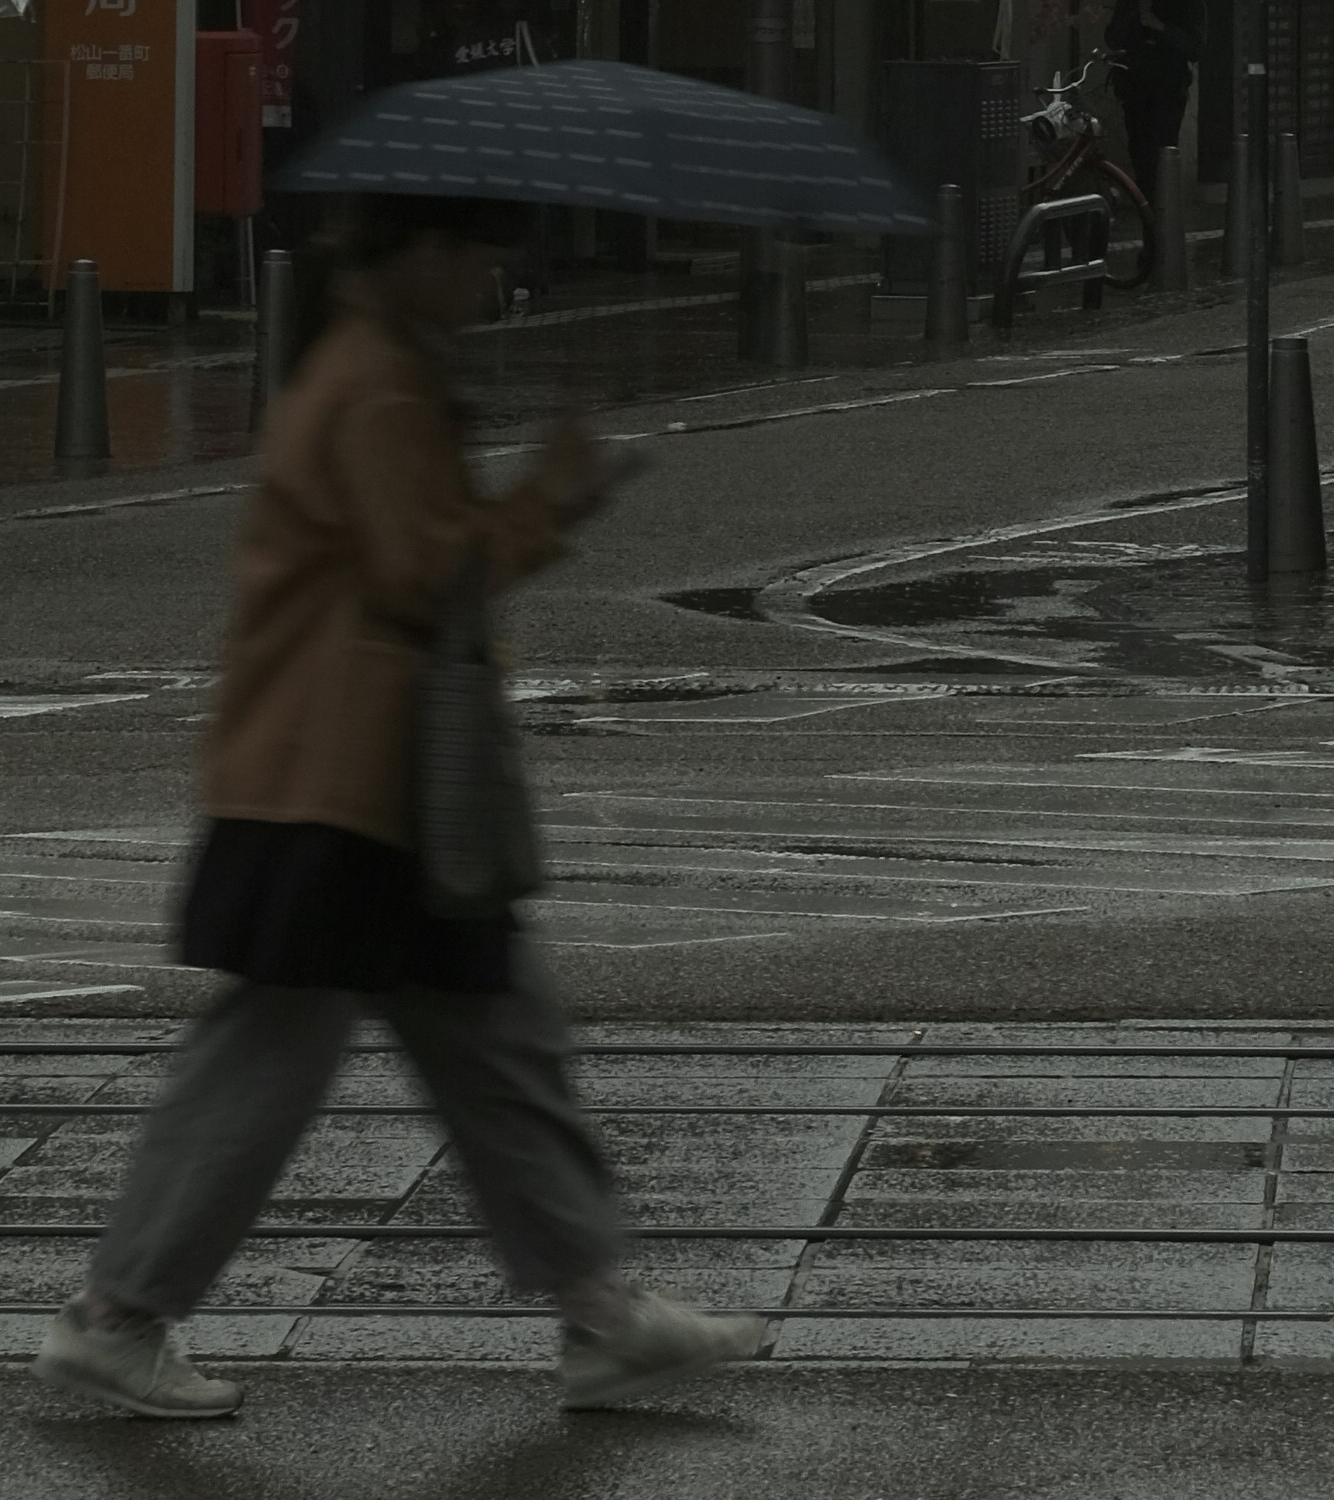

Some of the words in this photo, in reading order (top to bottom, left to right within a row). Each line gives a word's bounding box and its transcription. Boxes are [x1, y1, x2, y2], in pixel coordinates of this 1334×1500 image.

[70, 44, 150, 62] 松山一番町
[85, 64, 134, 81] 郵便局
